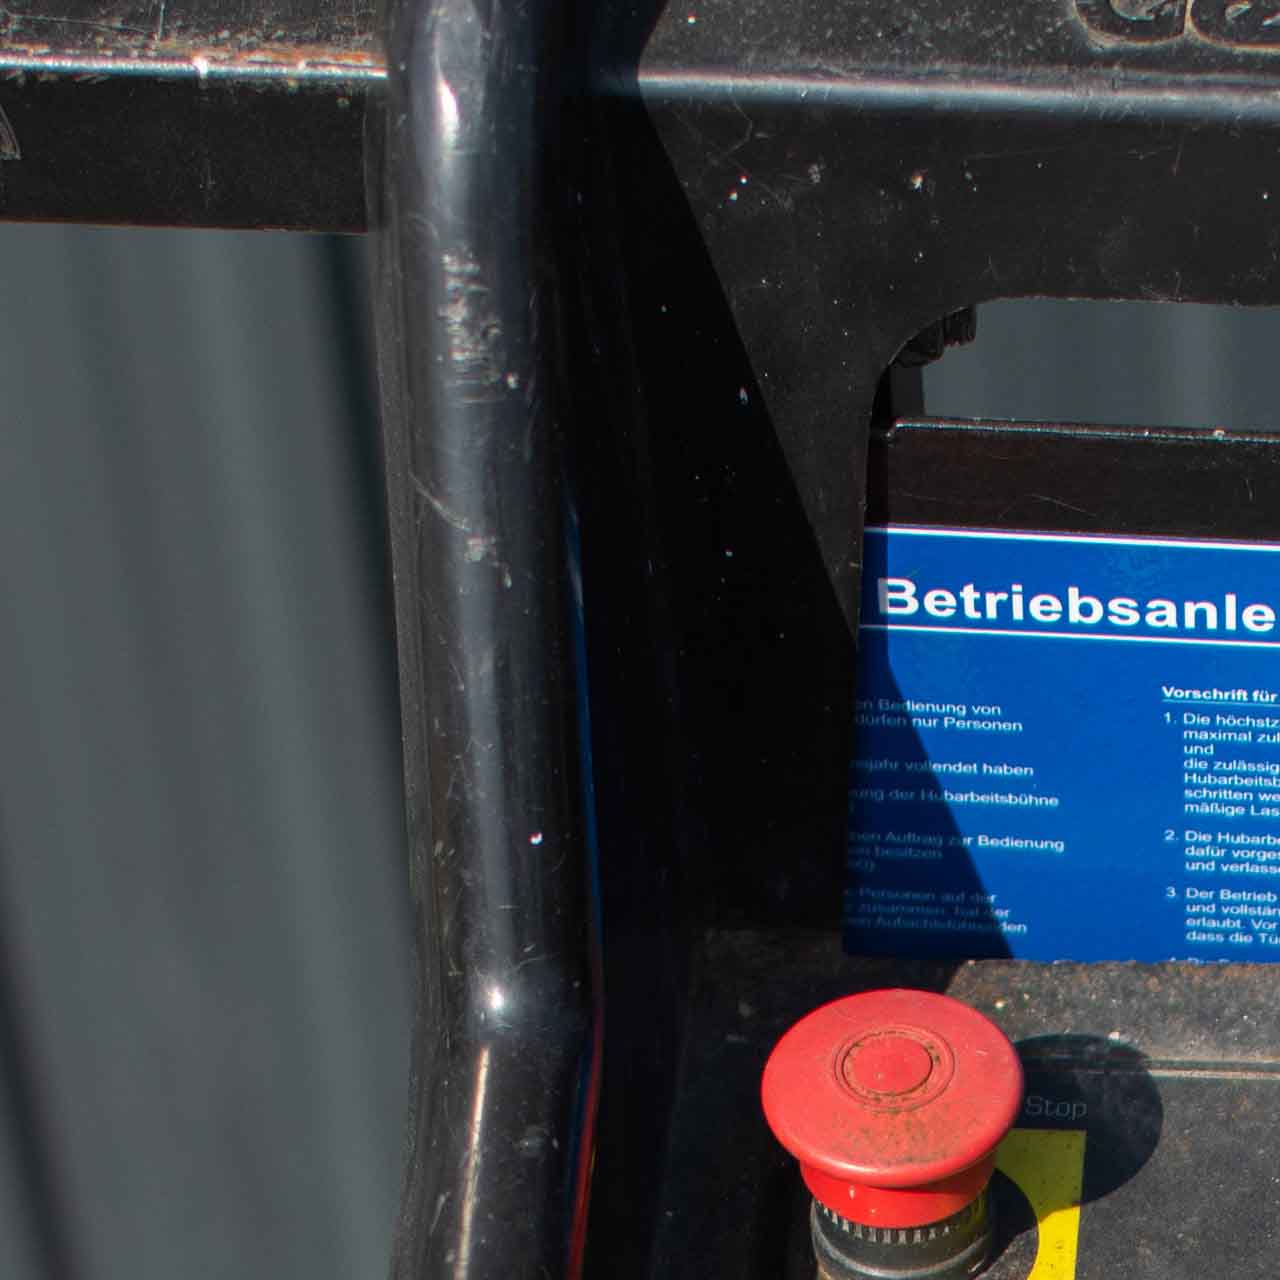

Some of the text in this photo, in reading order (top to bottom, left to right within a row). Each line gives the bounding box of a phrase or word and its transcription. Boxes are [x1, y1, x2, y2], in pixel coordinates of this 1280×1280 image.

[1162, 686, 1248, 701] Vorschrift
[1252, 689, 1276, 702] für
[878, 698, 967, 718] Bedienung
[971, 703, 1002, 716] von
[911, 716, 940, 727] nur
[943, 716, 1024, 732] Personen
[1164, 711, 1178, 725] 1.
[1183, 712, 1210, 725] Die
[1183, 729, 1252, 742] maximal
[1183, 743, 1214, 755] und
[905, 759, 979, 775] vollendet
[982, 760, 1035, 777] haben
[1183, 757, 1209, 769] die
[888, 787, 916, 801] der
[920, 787, 1060, 808] Hubarbeitsbühne
[1184, 787, 1254, 801] schritten
[1184, 801, 1245, 816] mäßige
[1164, 829, 1179, 841] 2.
[1184, 829, 1213, 842] Die
[977, 834, 1065, 853] Bedienung
[1185, 845, 1227, 858] dafür
[1185, 860, 1215, 871] und
[1185, 887, 1215, 900] Der
[1219, 888, 1278, 903] Betrieb
[1186, 902, 1216, 914] und
[1185, 917, 1246, 929] erlaubt.
[1250, 918, 1279, 931] Vor
[1186, 930, 1224, 942] dass
[1228, 931, 1253, 943] die
[1024, 1095, 1088, 1120] Stop
